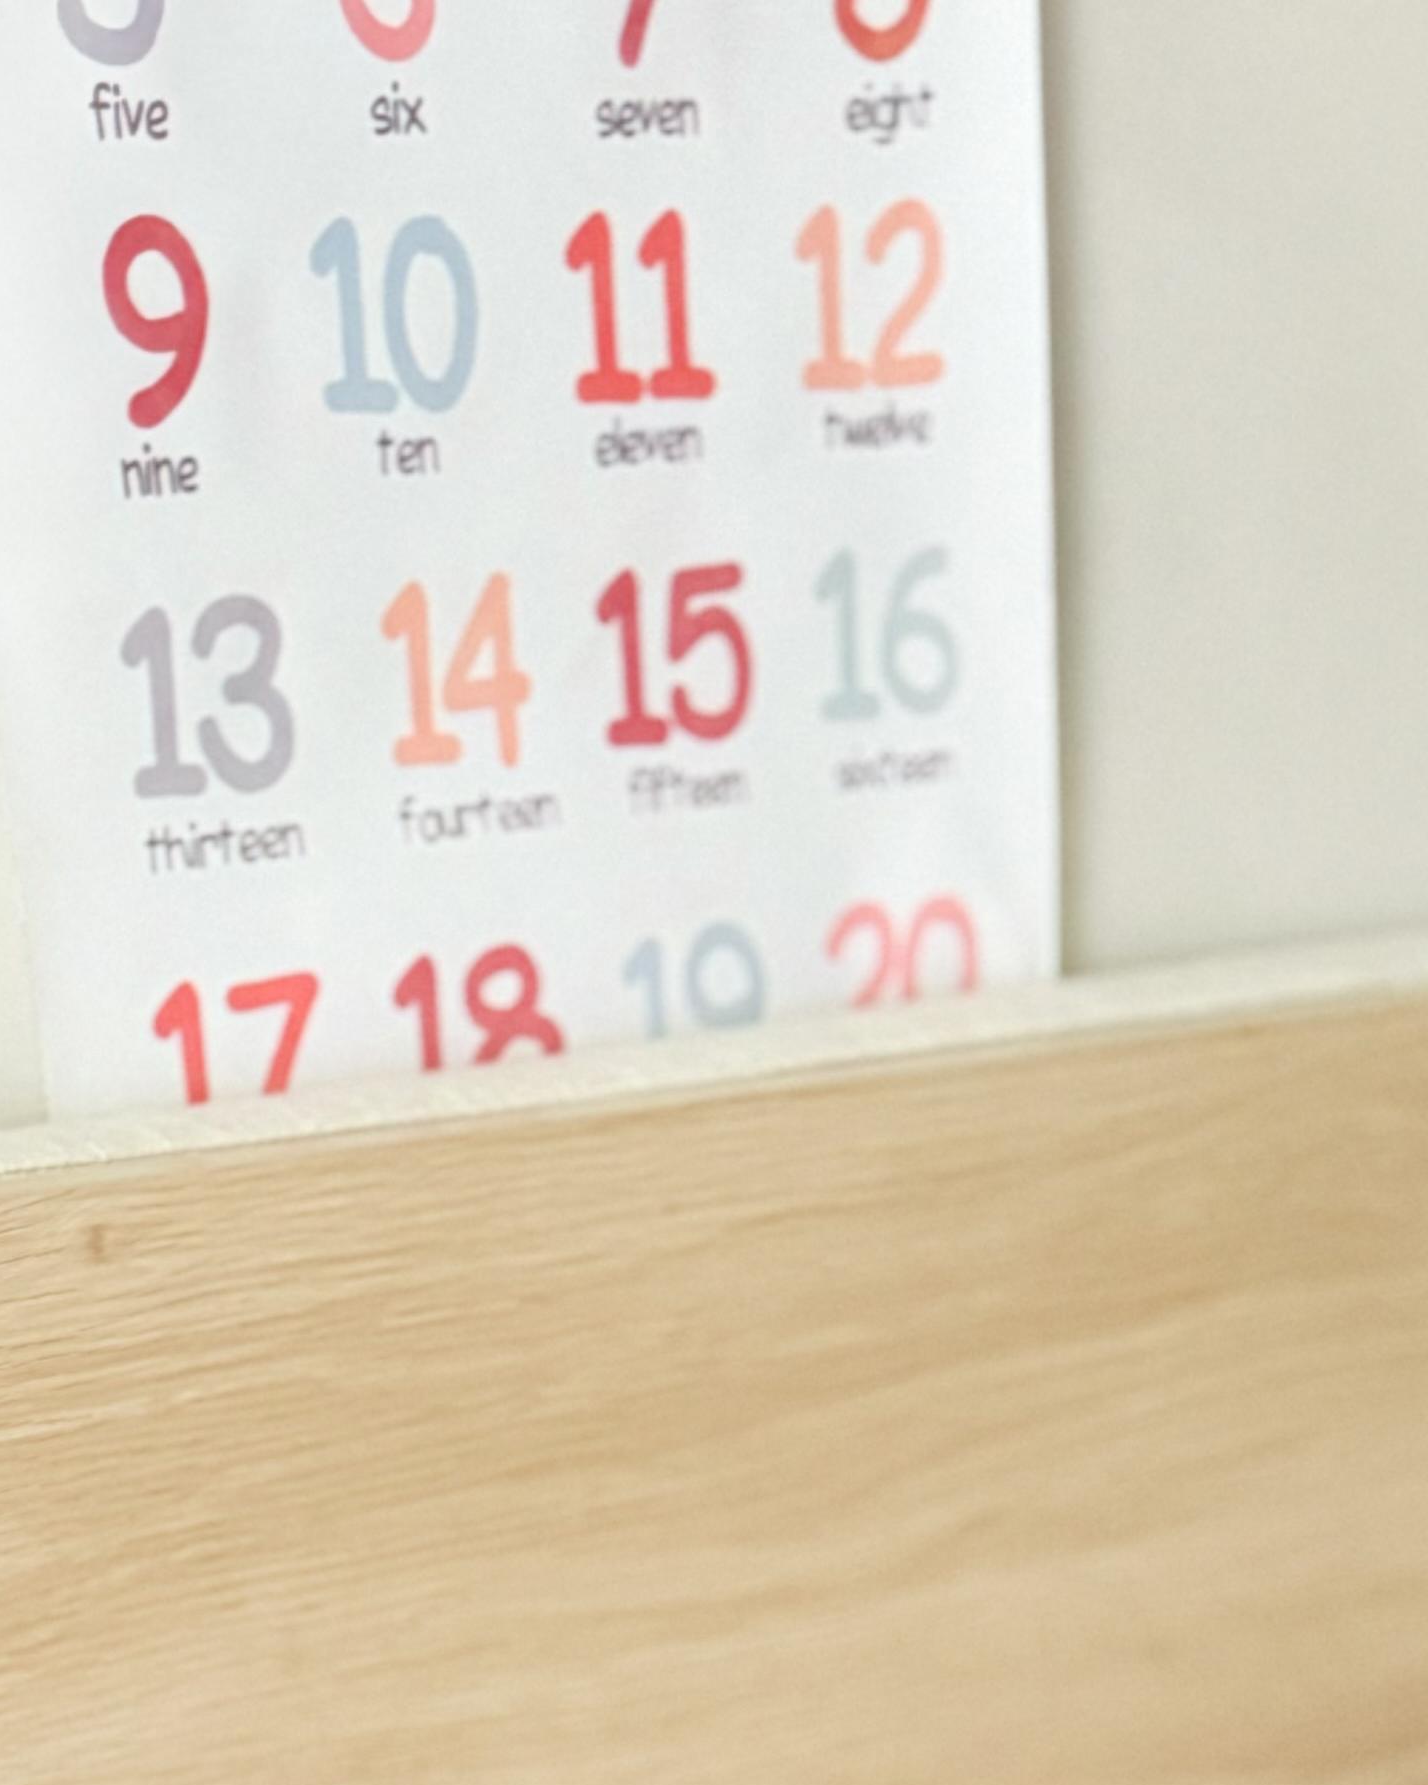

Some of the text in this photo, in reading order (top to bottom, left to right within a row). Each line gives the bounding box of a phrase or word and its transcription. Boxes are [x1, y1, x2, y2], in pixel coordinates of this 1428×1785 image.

[90, 82, 169, 140] five
[370, 82, 426, 136] six
[596, 97, 700, 139] seven
[102, 214, 209, 429] 9
[309, 214, 479, 414] 10
[565, 209, 717, 404] 11
[795, 198, 944, 392] 12
[121, 443, 198, 498] nine
[376, 431, 439, 475] ten
[594, 419, 700, 468] eleven
[120, 594, 295, 799] 13
[380, 571, 532, 768] 14
[595, 562, 753, 748] 15
[812, 545, 958, 723] 16
[145, 822, 304, 872] thirteen
[152, 971, 320, 1107] 17
[393, 944, 567, 1074] 18
